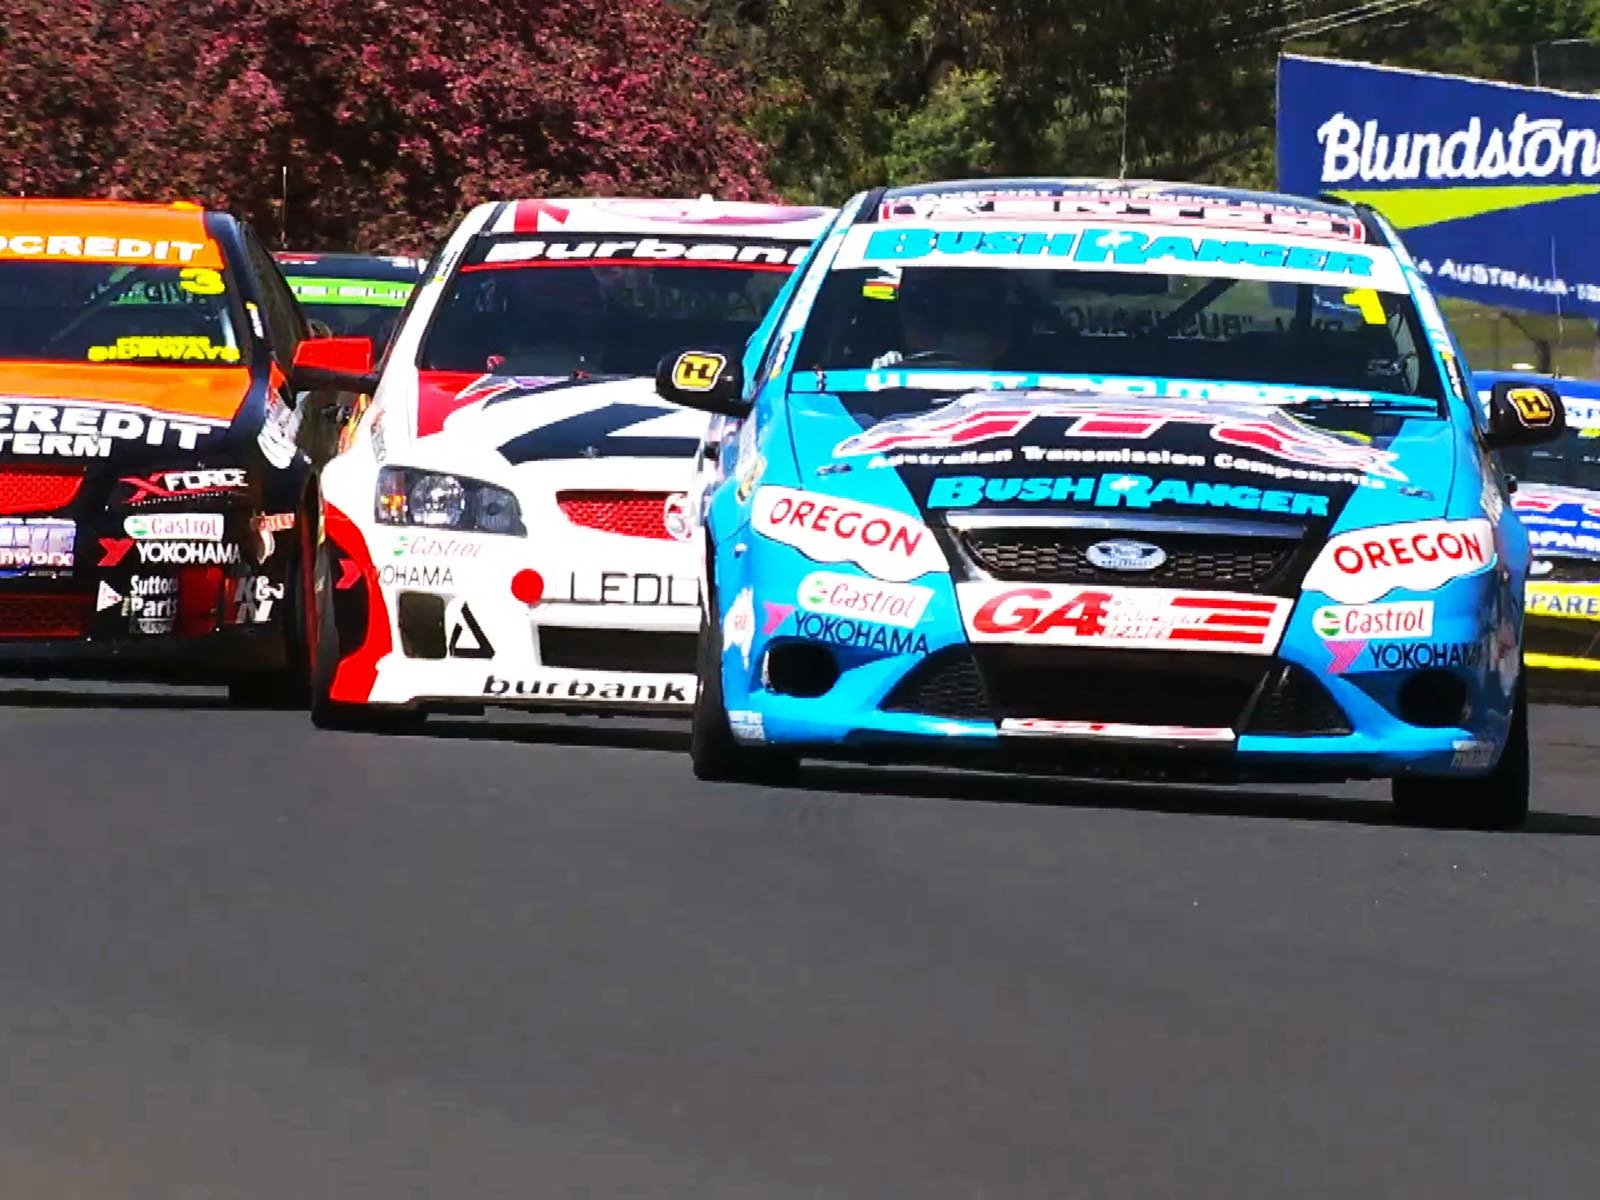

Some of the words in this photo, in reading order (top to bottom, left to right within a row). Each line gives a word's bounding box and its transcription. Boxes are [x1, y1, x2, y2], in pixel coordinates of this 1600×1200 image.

[1317, 112, 1600, 182] Blundston
[180, 267, 225, 295] 3
[1342, 287, 1387, 325] 1
[1021, 445, 1206, 466] Transmission
[151, 516, 217, 537] Castrol
[770, 498, 922, 556] OREGON
[135, 540, 241, 565] YOKOHAMA
[1333, 533, 1485, 575] OREGON
[376, 563, 455, 586] OHAMA
[829, 582, 916, 619] Castrol
[794, 610, 930, 656] YOKOHAMA
[1344, 606, 1426, 636] Castrol
[483, 675, 687, 702] burbank
